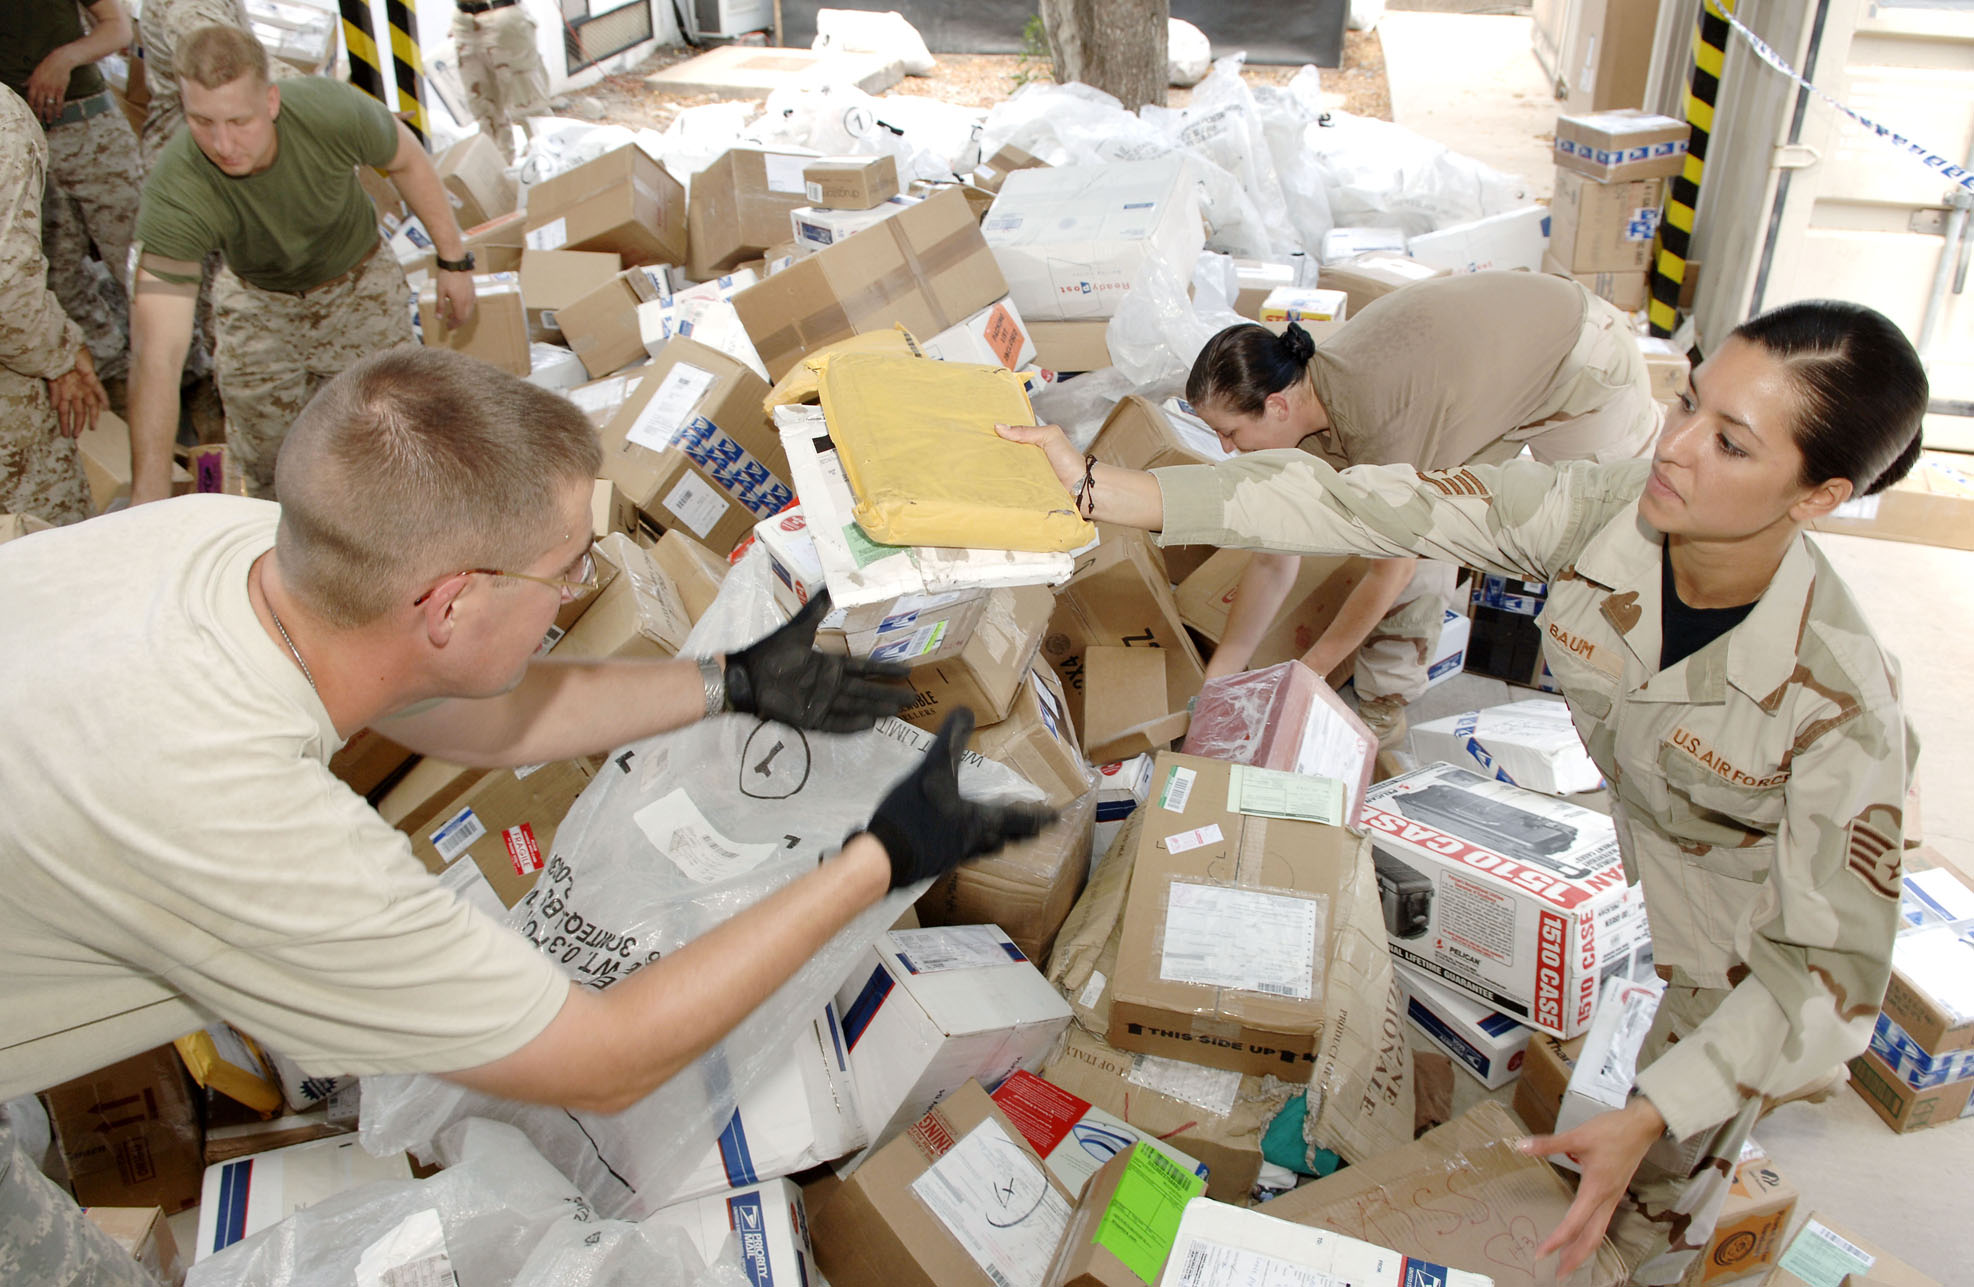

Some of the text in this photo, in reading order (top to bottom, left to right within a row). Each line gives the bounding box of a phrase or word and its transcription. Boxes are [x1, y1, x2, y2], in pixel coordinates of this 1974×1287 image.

[1549, 623, 1595, 660] BAUM
[876, 717, 920, 746] LIMIT
[1672, 728, 1700, 757] U.S.
[1700, 751, 1732, 777] AIR
[511, 830, 532, 867] FRAGILE
[1458, 848, 1571, 904] 1510
[1449, 947, 1480, 966] PELICAN
[1536, 916, 1562, 1031] 1510 CASE
[1577, 908, 1596, 1027] 1510 CASE
[1404, 952, 1442, 978] LIFETIME
[1443, 968, 1494, 1002] GUARANTEE
[1148, 1027, 1277, 1056] THIS SIDE UP
[1328, 1008, 1348, 1059] PRODUCT
[1065, 1046, 1097, 1066] ITALY
[1099, 1060, 1116, 1073] OF
[918, 1115, 953, 1155] RNING
[743, 1233, 752, 1259] MAIL
[753, 1233, 768, 1279] PRIORITY
